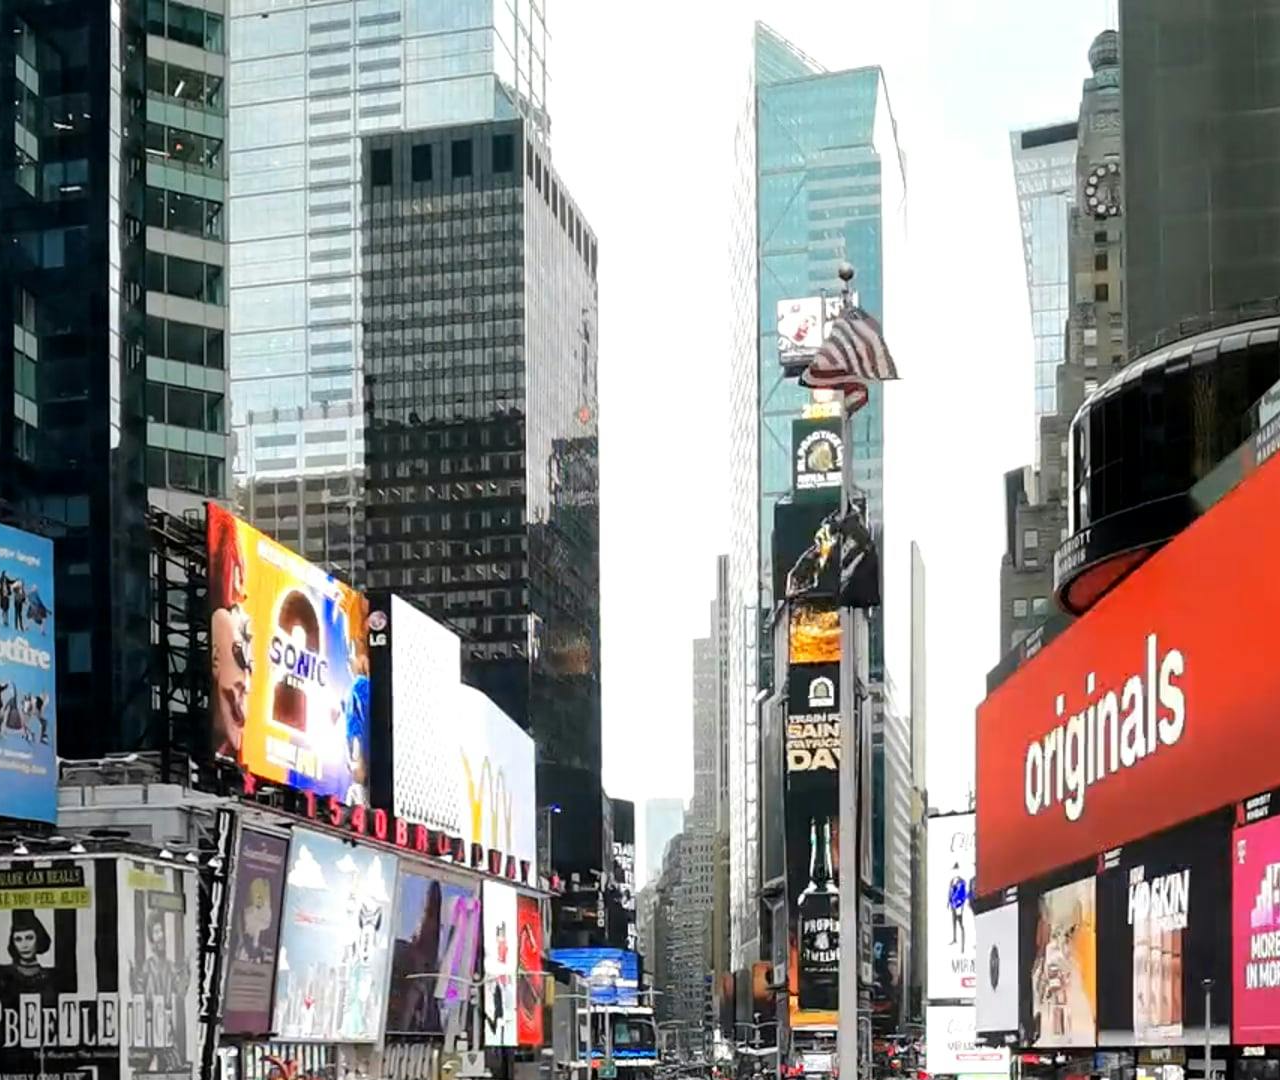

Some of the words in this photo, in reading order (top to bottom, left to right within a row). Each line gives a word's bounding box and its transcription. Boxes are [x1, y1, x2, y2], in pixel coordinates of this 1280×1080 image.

[270, 635, 328, 687] SONIC
[369, 634, 387, 647] LG
[786, 723, 841, 739] SAIN
[1025, 633, 1185, 820] originals
[305, 797, 388, 840] 1540
